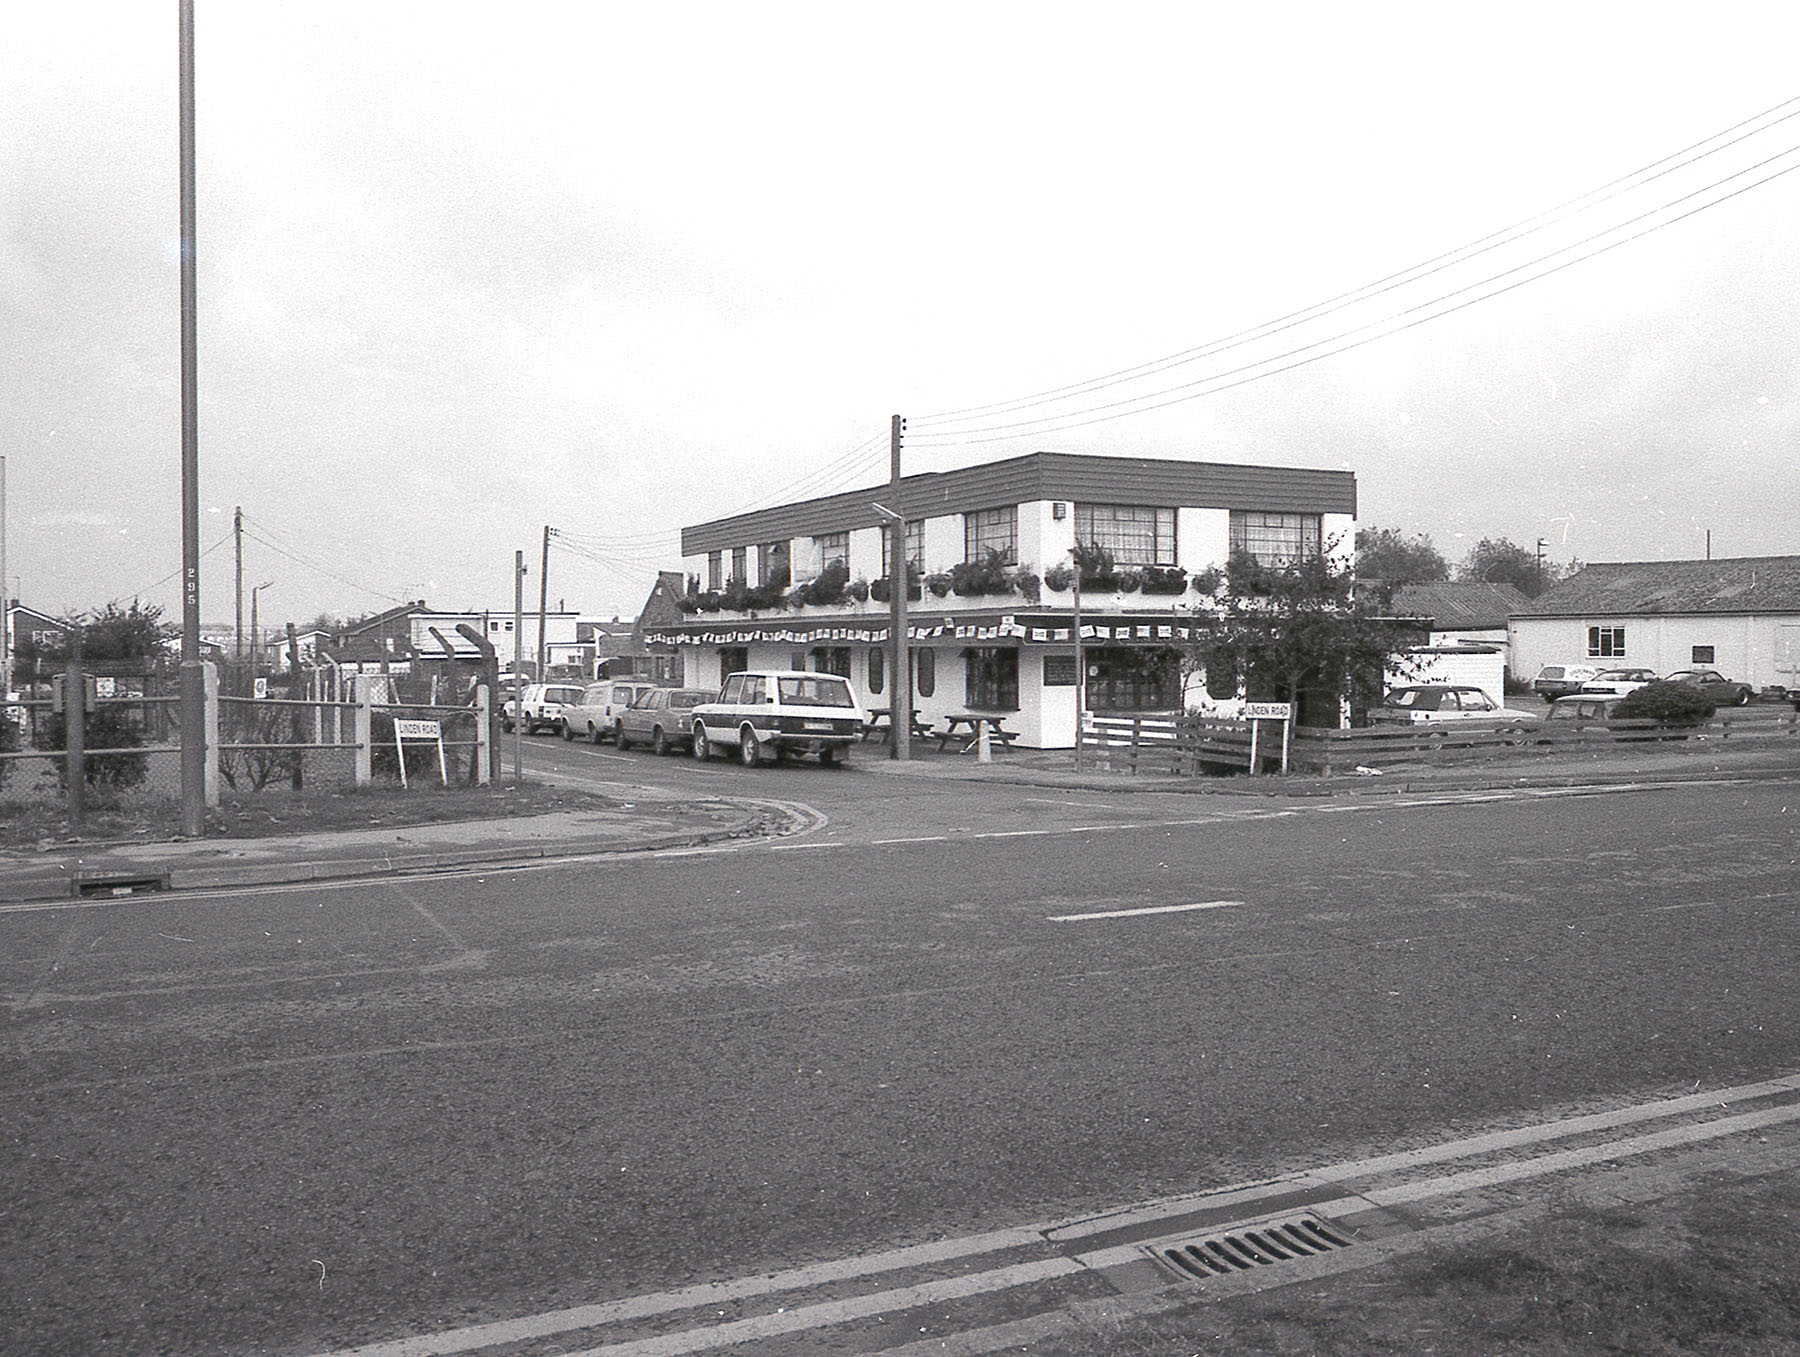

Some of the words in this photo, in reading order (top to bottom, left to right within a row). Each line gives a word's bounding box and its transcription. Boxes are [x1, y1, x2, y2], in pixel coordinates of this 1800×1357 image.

[187, 567, 196, 605] 295
[1247, 705, 1269, 716] LINDEN
[1270, 705, 1288, 717] ROAD
[400, 723, 421, 734] LINDEN
[422, 724, 438, 735] ROAD
